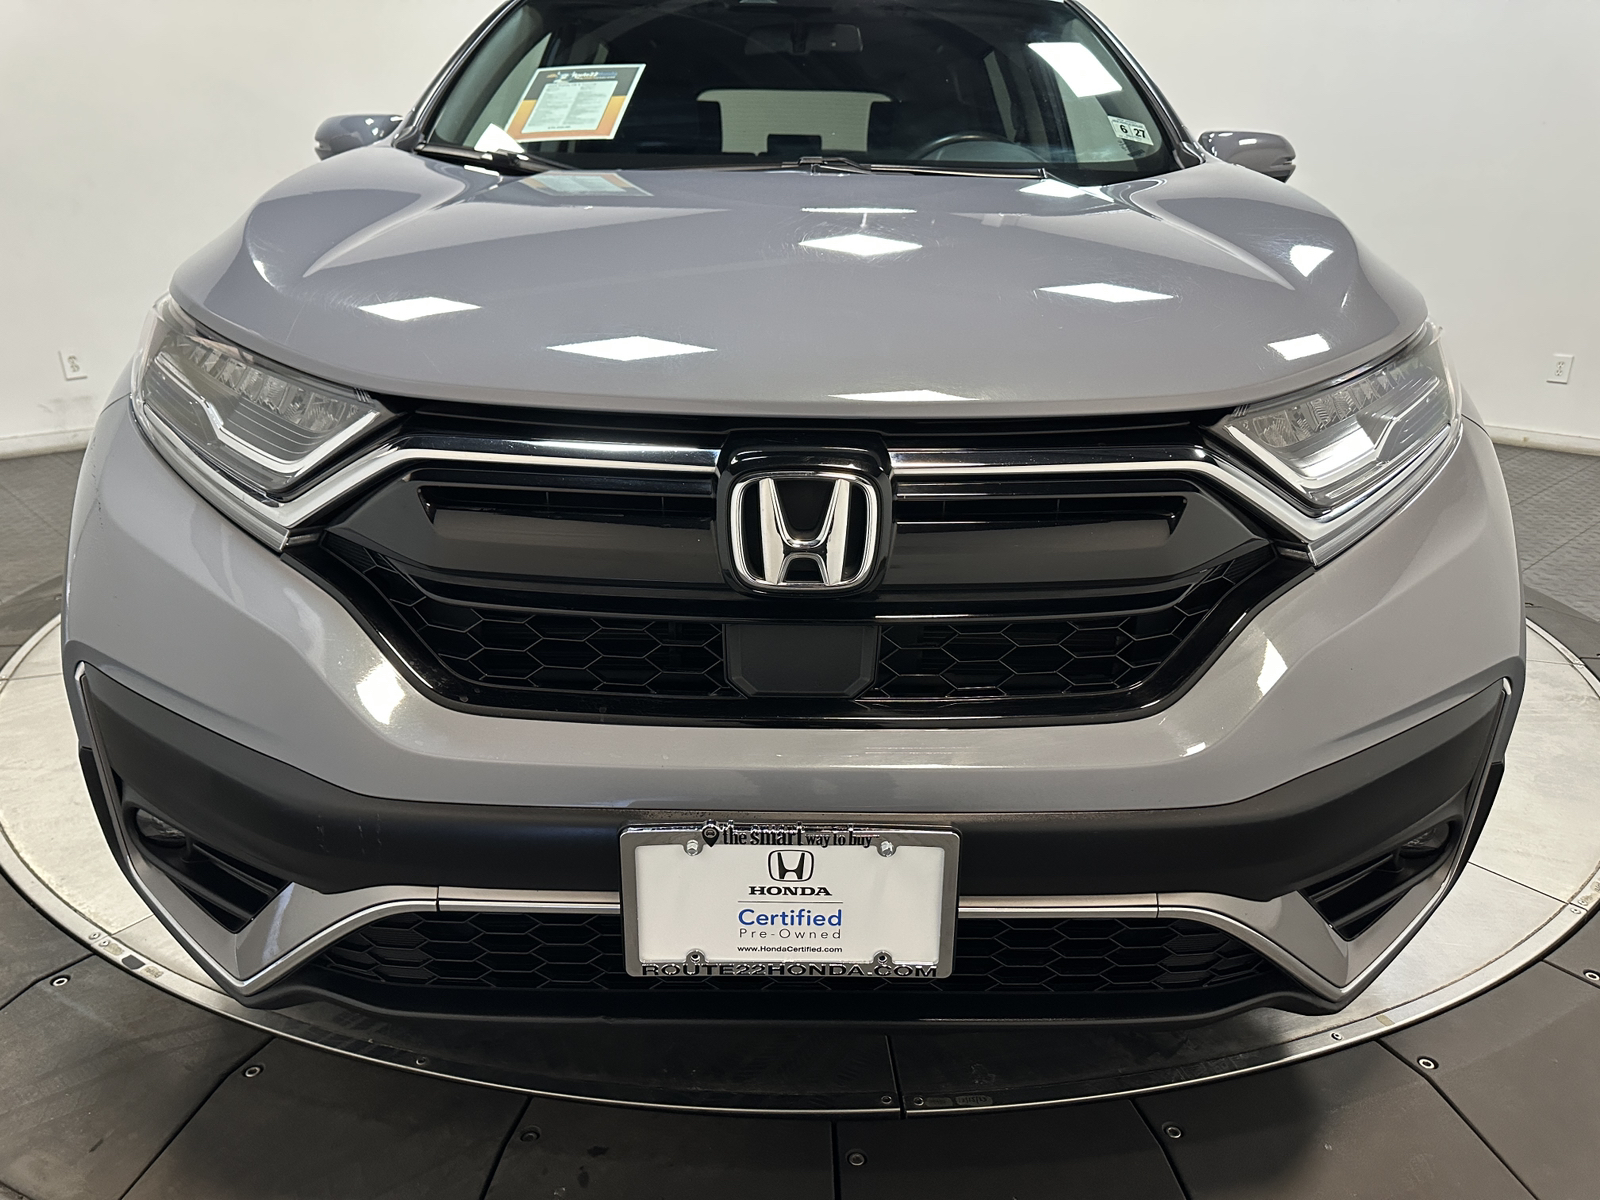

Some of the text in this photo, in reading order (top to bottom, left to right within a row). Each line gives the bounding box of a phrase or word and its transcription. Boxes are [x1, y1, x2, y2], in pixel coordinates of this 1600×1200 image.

[1120, 124, 1128, 133] 6
[1133, 128, 1145, 138] 27
[722, 826, 872, 848] the smart way to buy
[749, 885, 832, 896] HONDA
[738, 908, 842, 926] Certified
[739, 928, 841, 939] Pre-Owned
[641, 963, 938, 977] ROUTE22HONDA.COM
